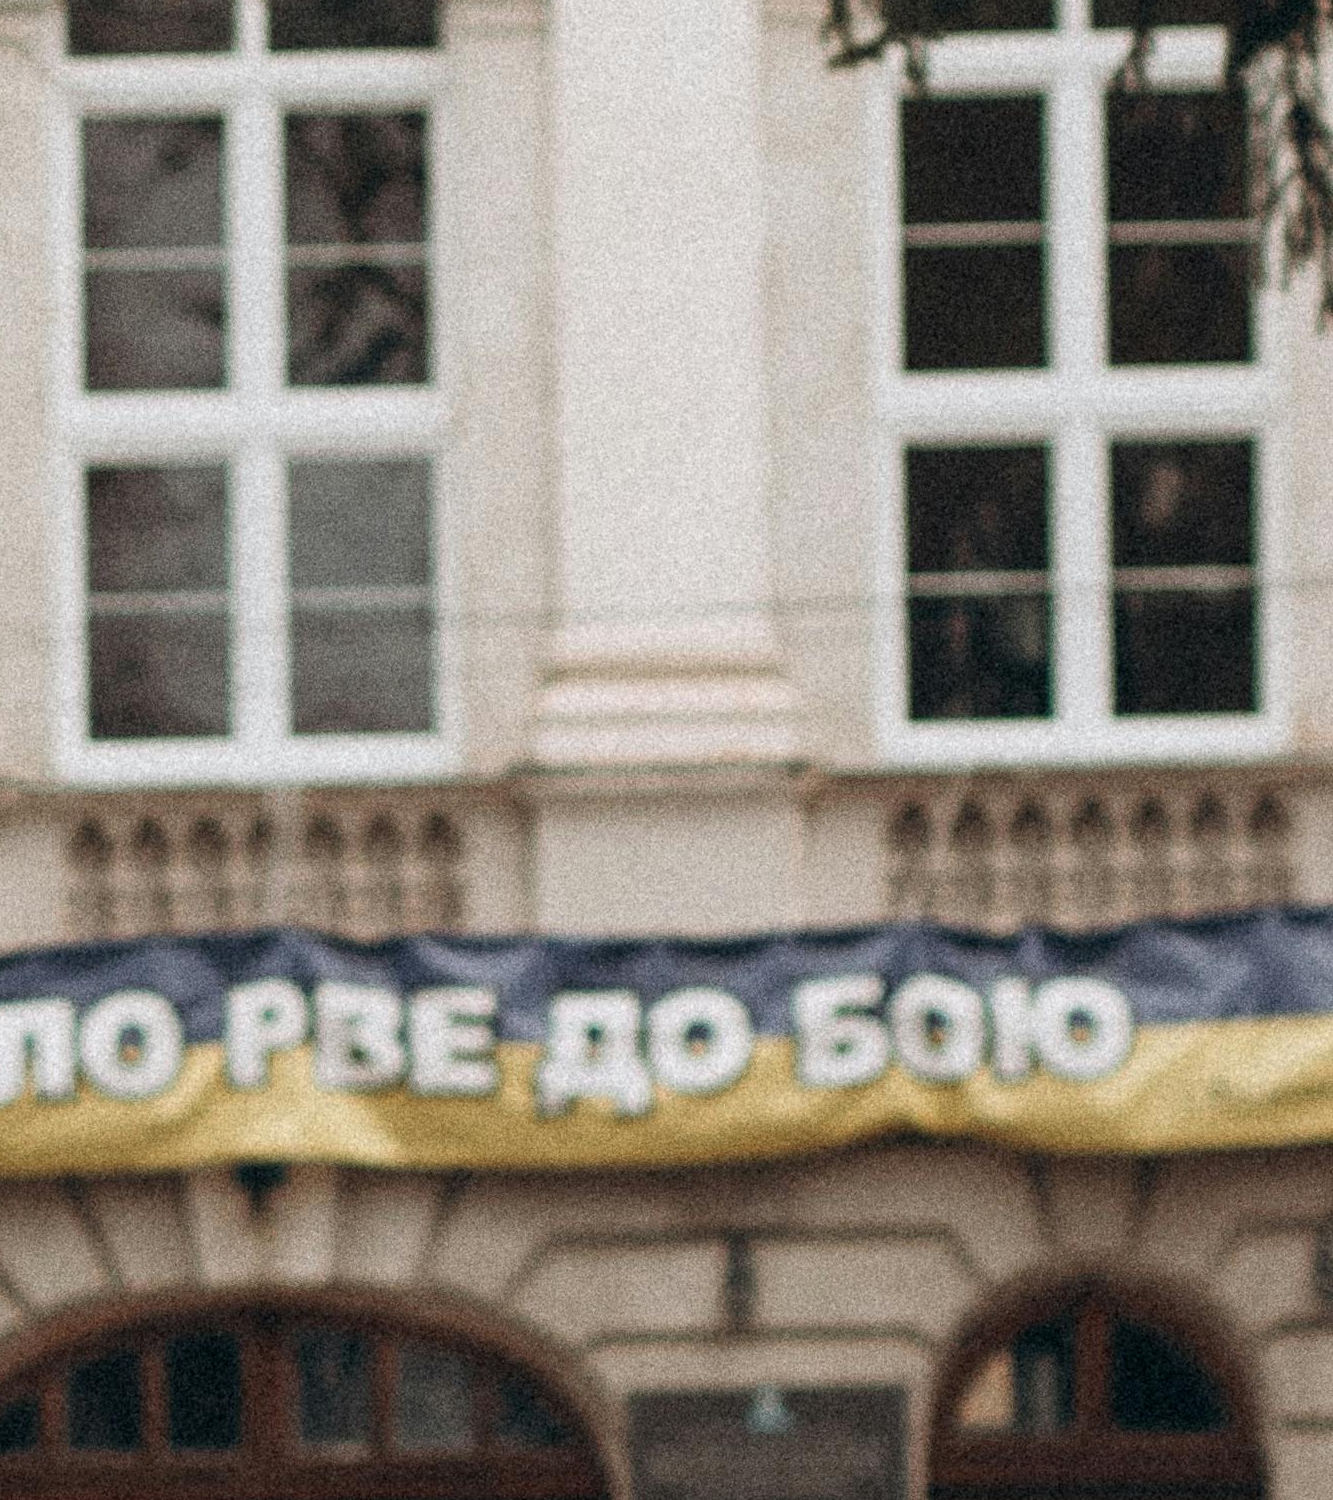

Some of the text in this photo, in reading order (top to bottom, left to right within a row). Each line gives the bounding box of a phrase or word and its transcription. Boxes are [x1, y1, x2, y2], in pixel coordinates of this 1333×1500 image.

[227, 978, 501, 1094] РВЕ
[538, 988, 753, 1114] ДО
[793, 974, 1131, 1088] БОЮ
